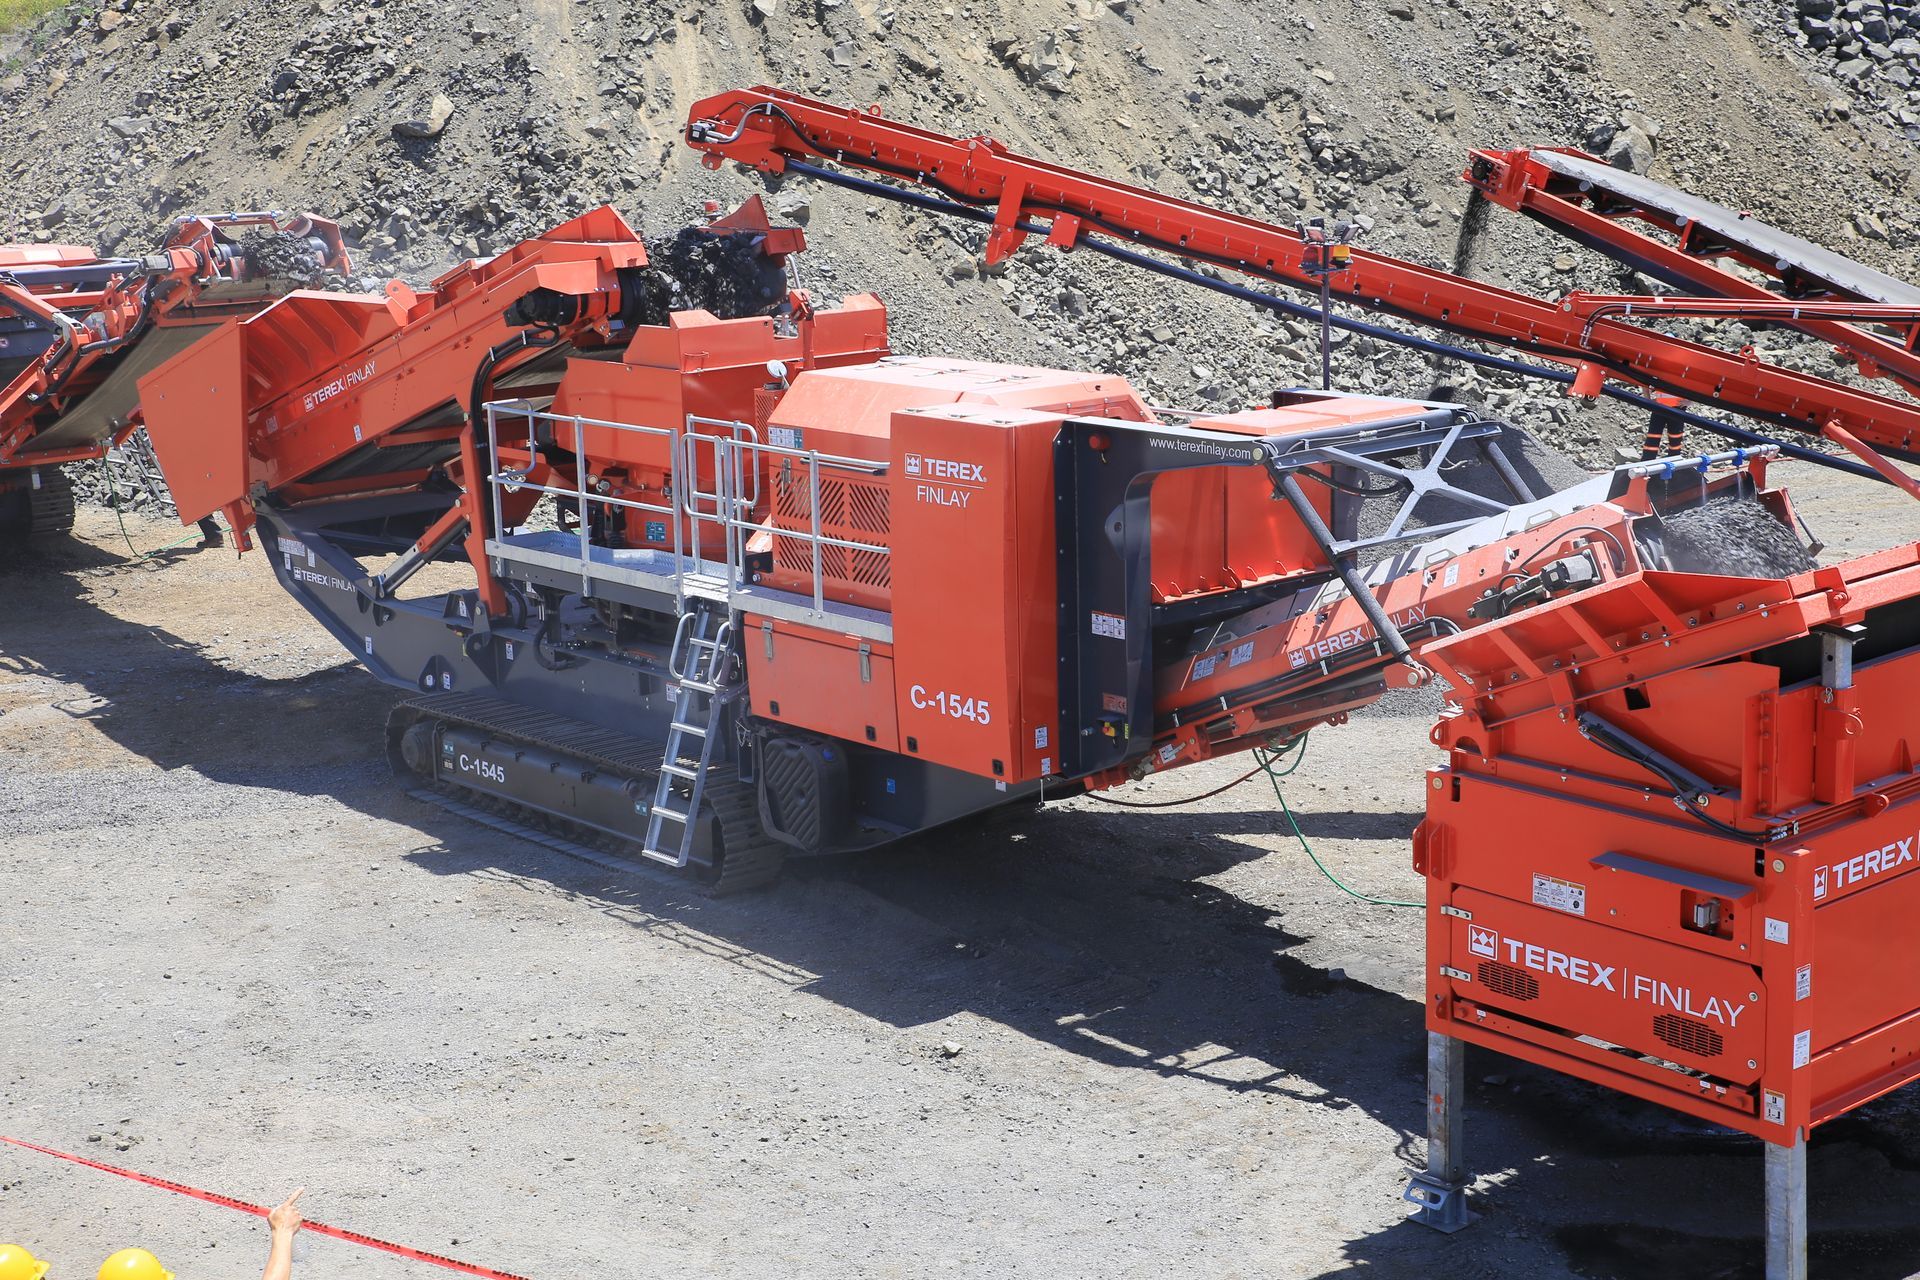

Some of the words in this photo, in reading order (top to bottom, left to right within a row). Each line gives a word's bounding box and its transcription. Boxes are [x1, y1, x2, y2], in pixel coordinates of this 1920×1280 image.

[312, 378, 346, 405] TEREX
[346, 360, 376, 387] FINLAY
[1149, 437, 1251, 460] www.terexfinlay.com
[924, 457, 985, 483] TEREX
[917, 485, 970, 508] FINLAY
[301, 570, 328, 587] TEREX
[331, 577, 356, 593] FINLAY
[1306, 626, 1366, 661] TEREX
[910, 684, 991, 725] C-1545
[459, 754, 505, 783] C-1545
[1832, 836, 1914, 889] TEREX
[1503, 937, 1616, 993] TEREX
[1634, 974, 1745, 1028] FINLAY
